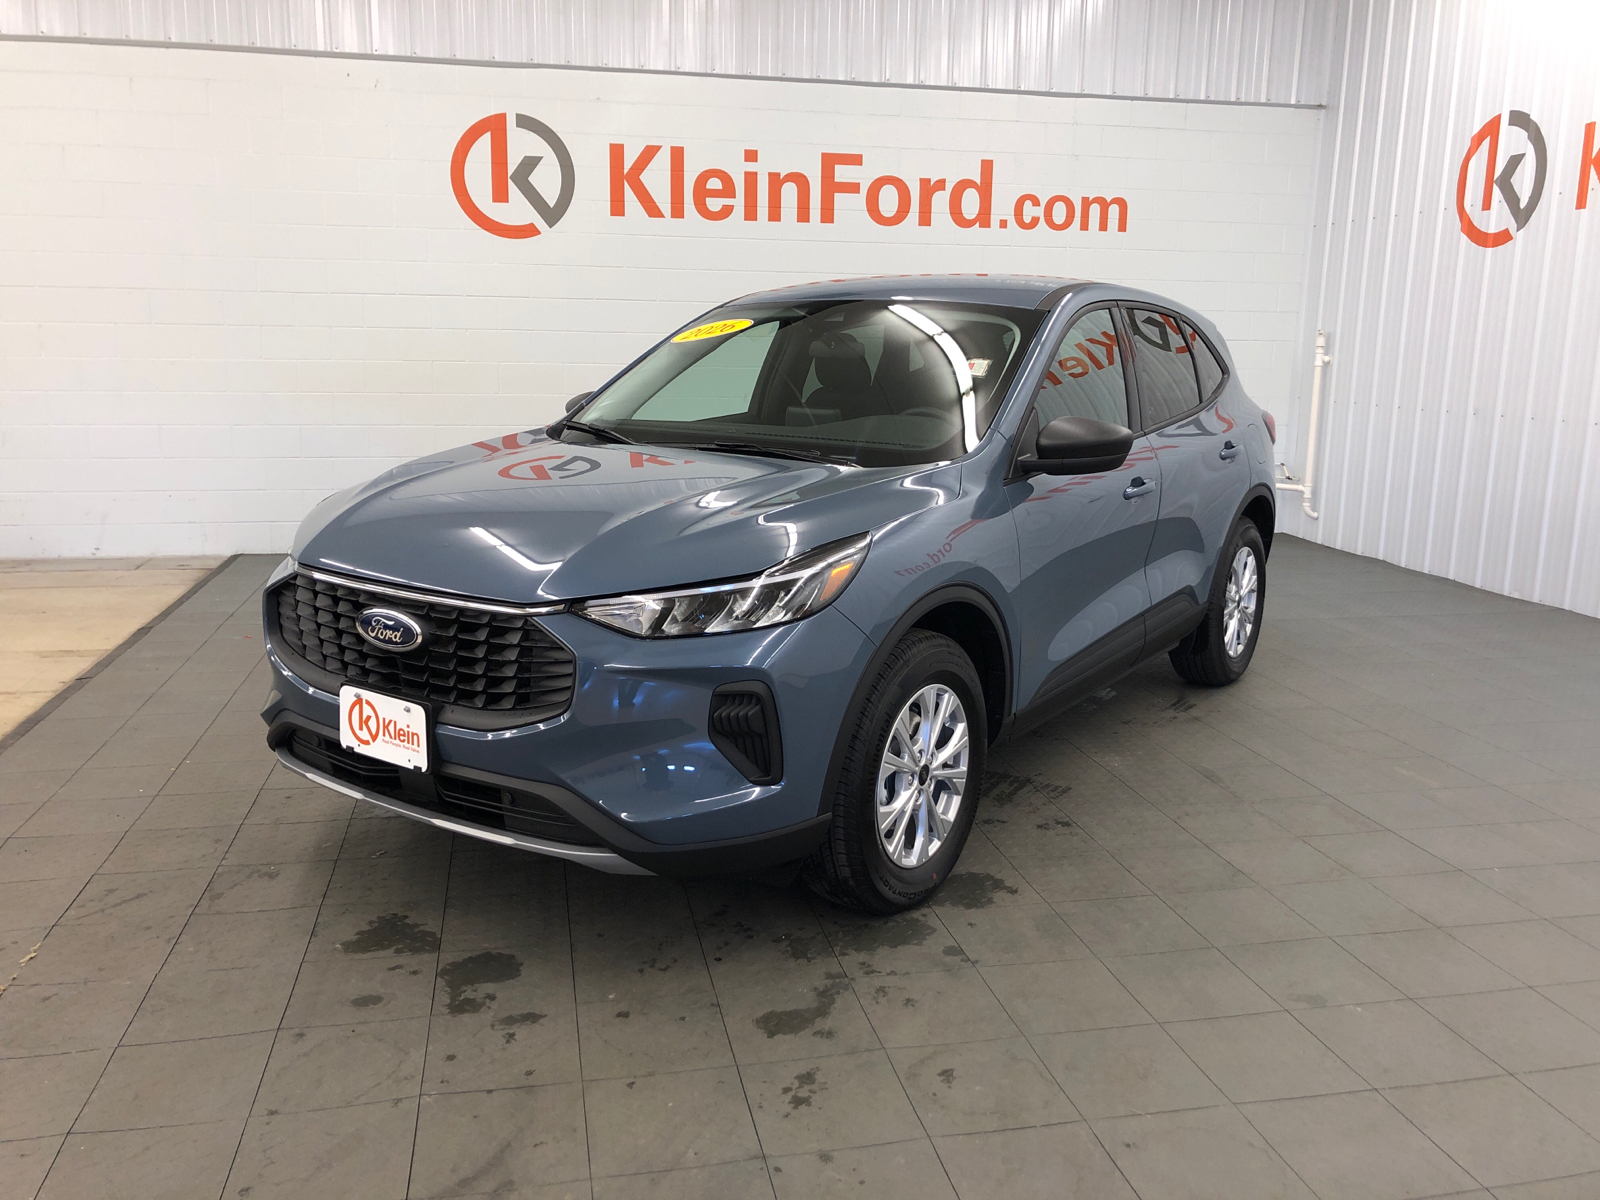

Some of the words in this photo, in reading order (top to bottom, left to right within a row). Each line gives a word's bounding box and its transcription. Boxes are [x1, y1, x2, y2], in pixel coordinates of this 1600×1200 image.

[608, 143, 1128, 232] KleinFord.com
[679, 320, 741, 341] 2026
[368, 616, 403, 643] Ford
[382, 717, 420, 748] Klein
